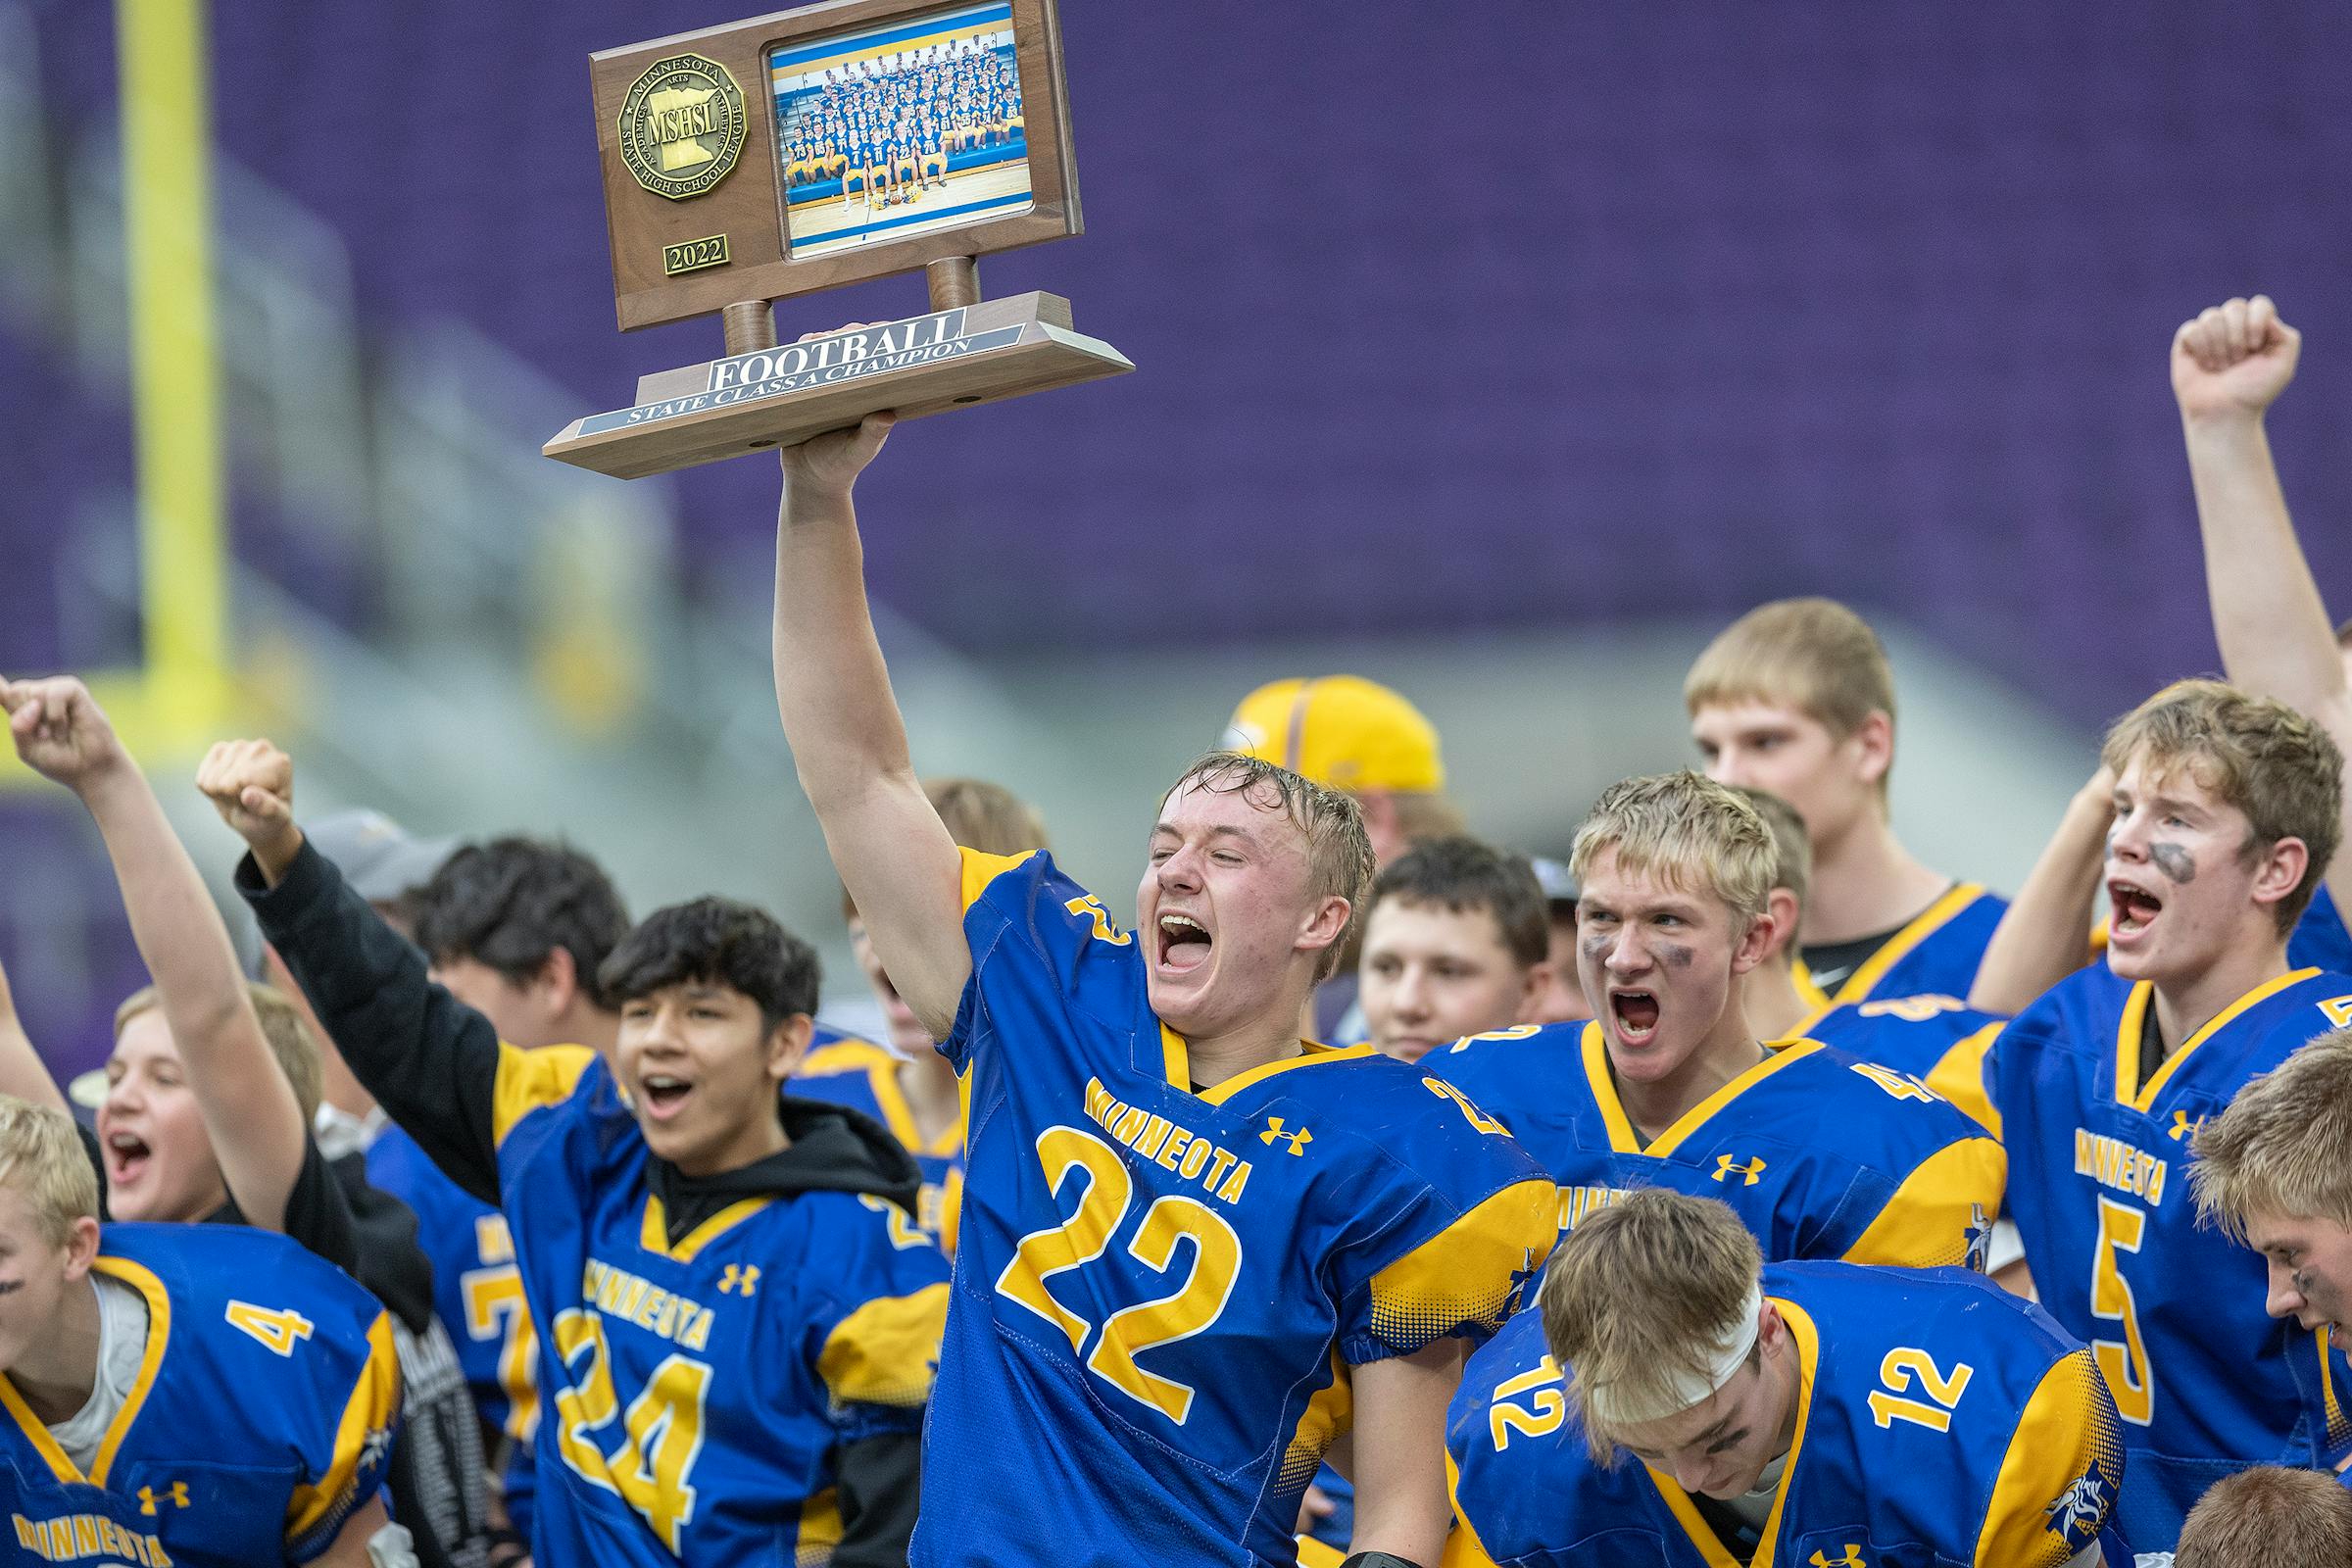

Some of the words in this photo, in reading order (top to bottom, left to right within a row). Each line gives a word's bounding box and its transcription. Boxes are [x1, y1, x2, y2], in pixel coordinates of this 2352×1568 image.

[633, 59, 719, 97] MINNESOTA
[666, 74, 689, 85] ARTS
[622, 130, 640, 172] STATE
[640, 170, 672, 193] HIGH
[675, 166, 726, 193] SCHOOL
[723, 104, 743, 164] LEAGUE
[636, 104, 658, 166] ACADEMICS
[647, 102, 718, 146] MSHSL
[714, 95, 727, 148] ATHLETICS
[669, 239, 722, 270] 2022
[626, 396, 707, 424] STATE
[714, 376, 796, 407] CLASS
[799, 373, 818, 388] A
[825, 338, 973, 380] CHAMPION
[712, 314, 962, 390] FOOTBALL
[1084, 1076, 1252, 1204] MINNEOTA
[995, 1125, 1243, 1426] 22
[2090, 1192, 2154, 1427] 5
[225, 1299, 315, 1358] 4
[1867, 1346, 1975, 1434] 12
[553, 1306, 714, 1558] 24
[11, 1512, 174, 1568] MINNEOTA
